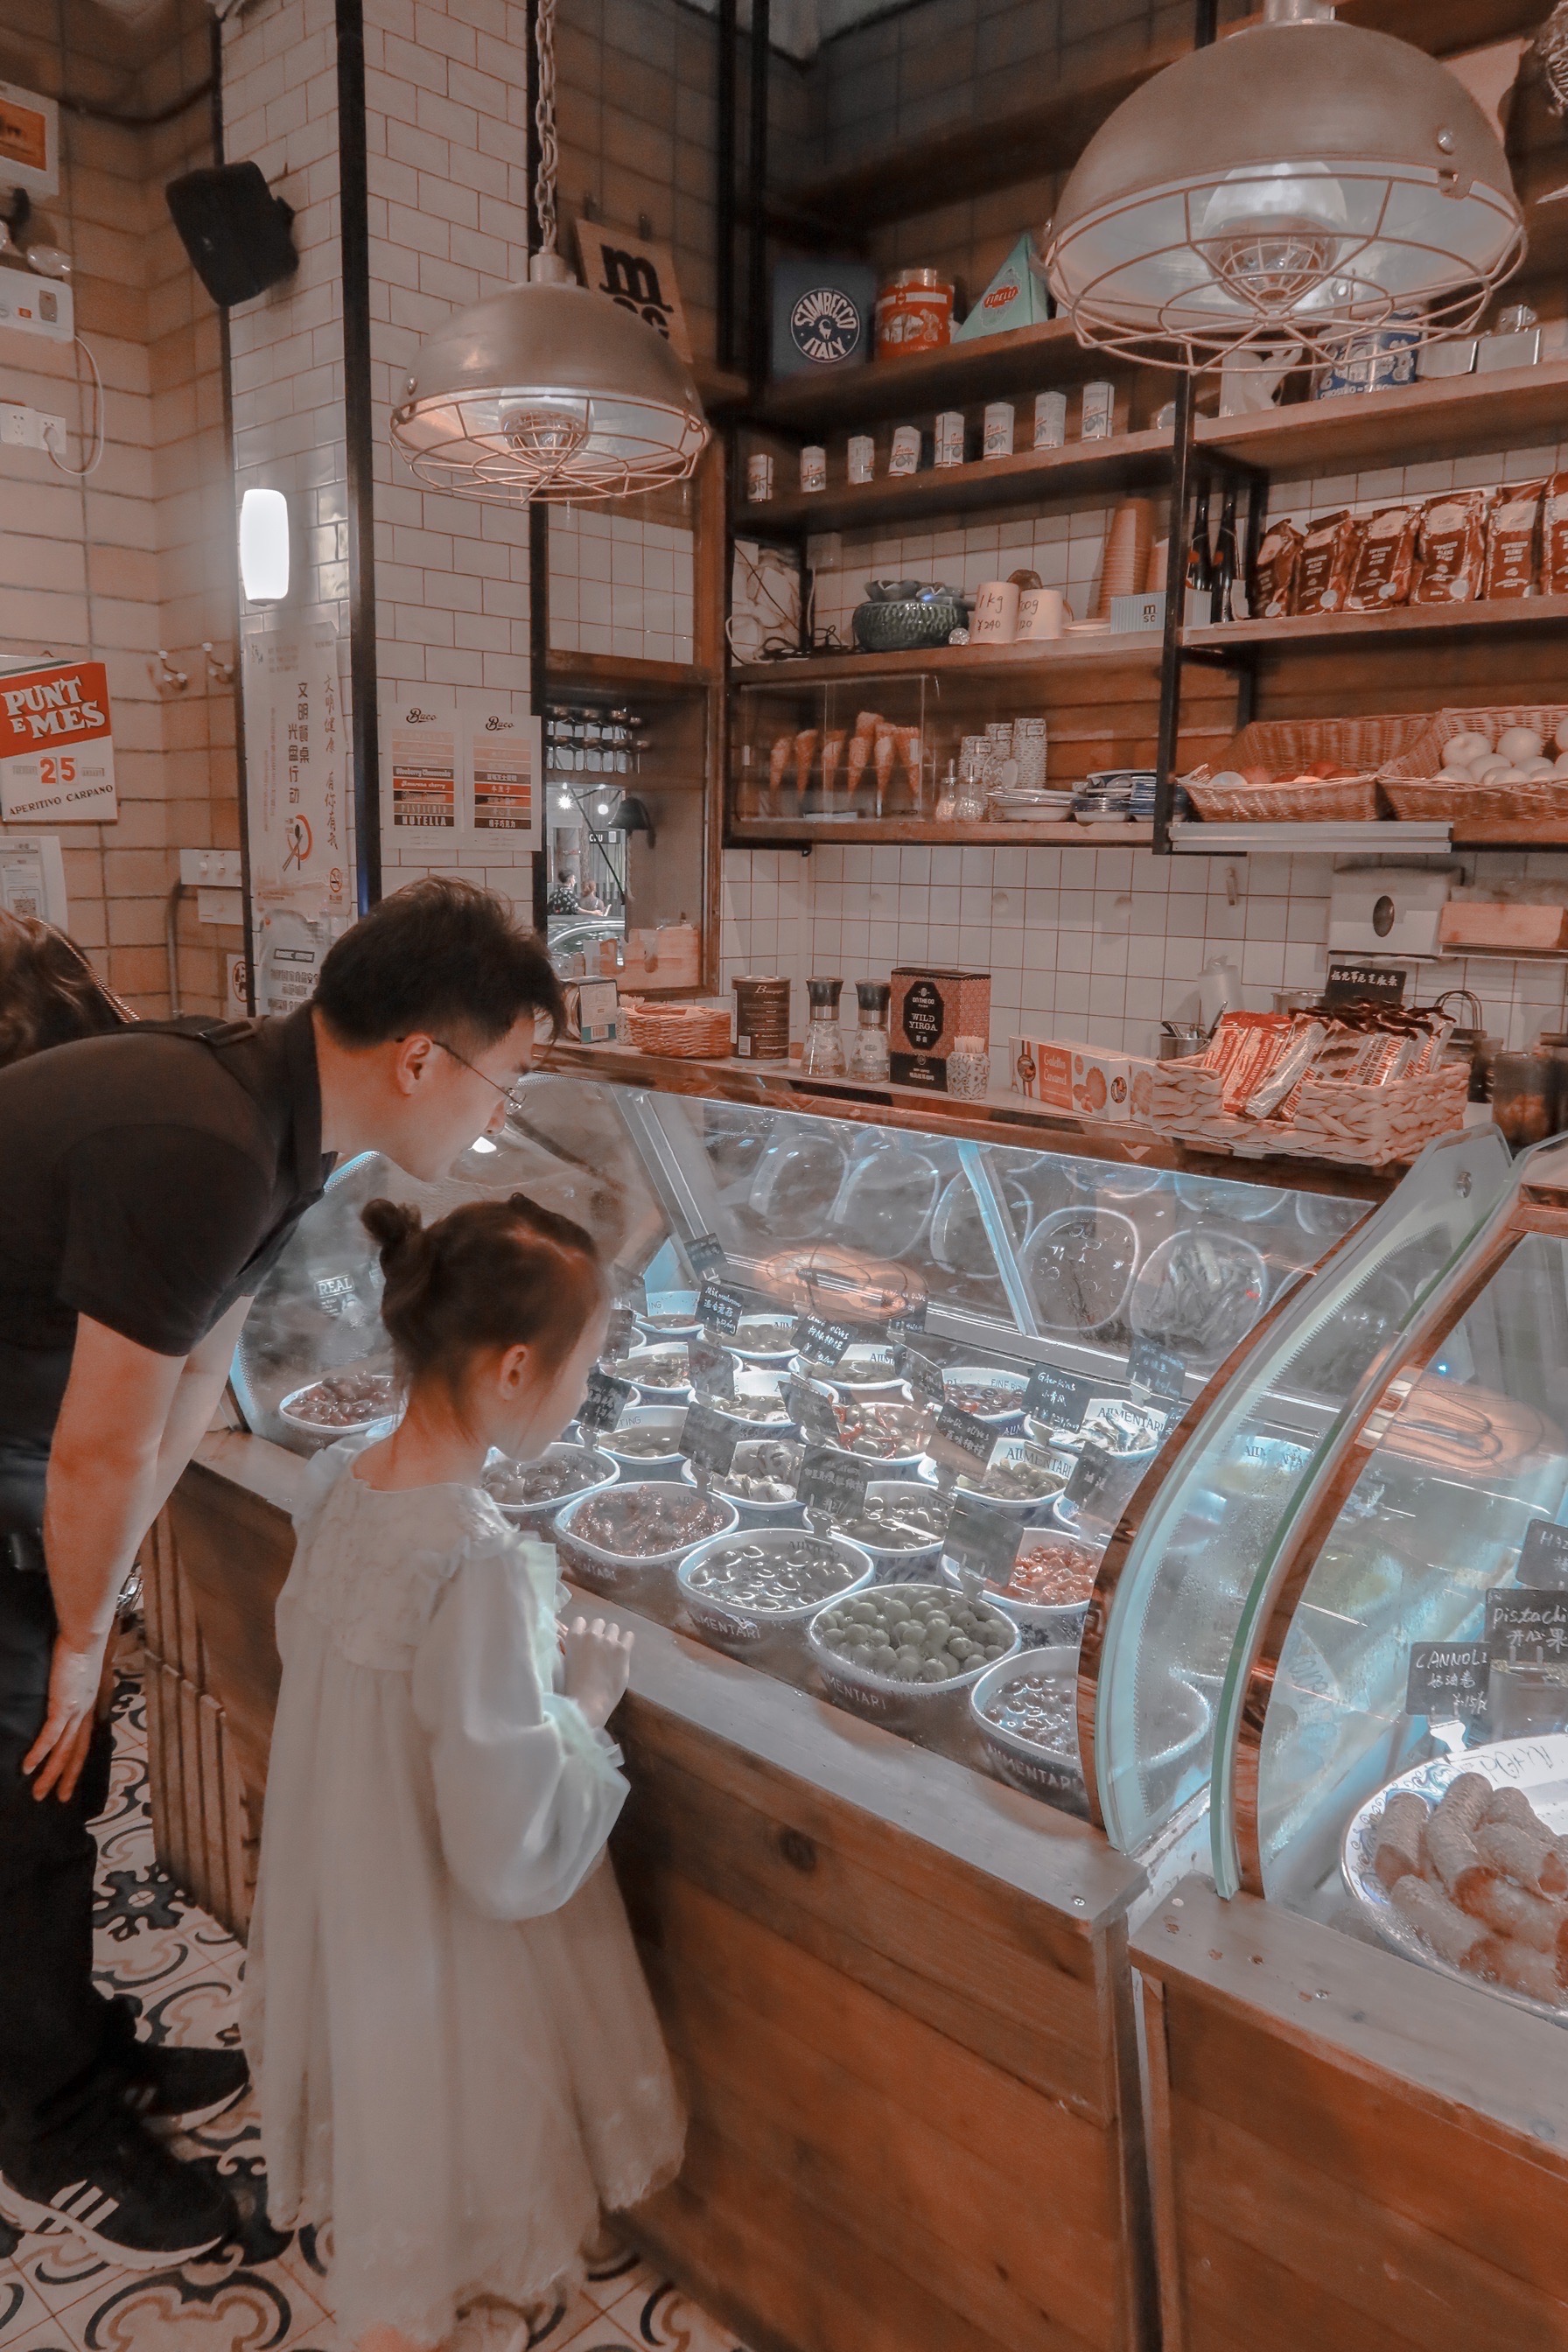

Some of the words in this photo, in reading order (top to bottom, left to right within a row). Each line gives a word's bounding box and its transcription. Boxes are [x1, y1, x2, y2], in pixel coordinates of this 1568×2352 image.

[794, 291, 858, 328] STAMBECCO
[803, 337, 846, 360] ITALY
[1, 676, 82, 716] PUNT
[10, 718, 26, 734] E
[25, 700, 106, 739] MES
[39, 756, 76, 784] 25
[9, 796, 61, 816] APERITIVO
[66, 784, 114, 802] CARPANO
[402, 816, 447, 826] NUTELLA
[909, 1021, 938, 1032] YIRGA
[911, 1013, 935, 1022] WILD
[318, 1278, 353, 1296] REAL
[1507, 1628, 1568, 1654] 开心果
[1416, 1649, 1488, 1669] CANNOLI
